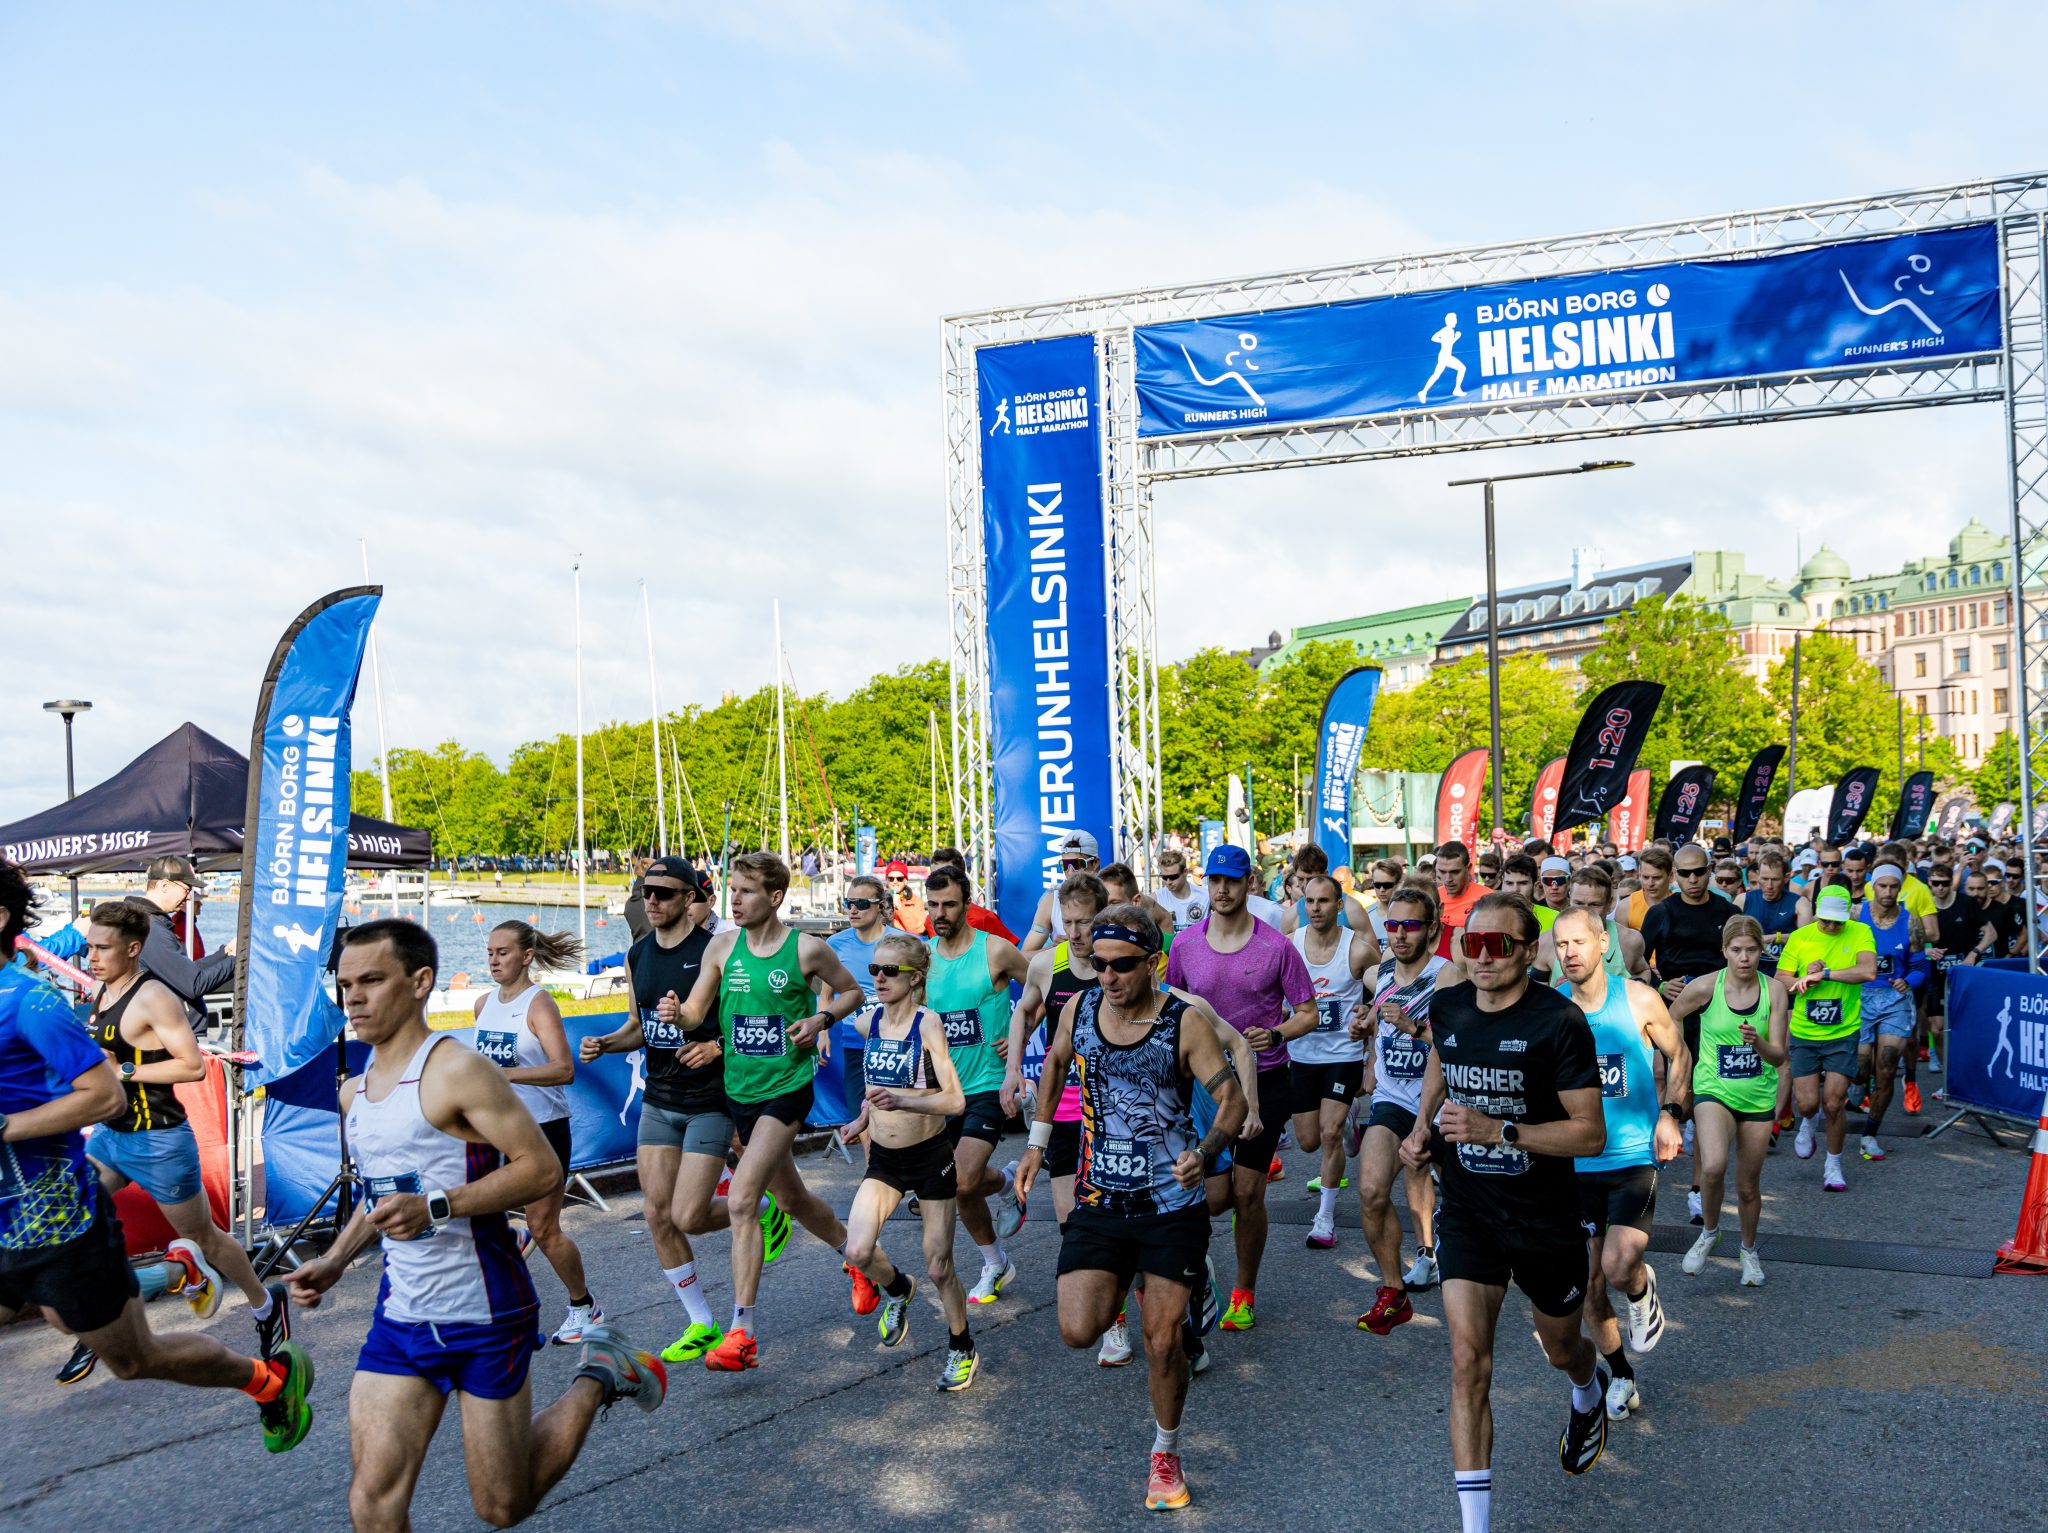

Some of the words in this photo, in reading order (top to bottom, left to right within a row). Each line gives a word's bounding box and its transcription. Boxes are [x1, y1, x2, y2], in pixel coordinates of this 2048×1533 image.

[1477, 297, 1559, 324] BJÖRN
[1566, 288, 1637, 315] BORG
[1478, 311, 1675, 377] HELSINKI
[1844, 338, 1909, 357] RUNNER'S
[1911, 335, 1945, 350] HIGH
[1014, 392, 1047, 404] BJÖRN
[1048, 388, 1075, 399] BORG
[1482, 379, 1539, 401] HALF
[1546, 365, 1676, 396] MARATHON
[1015, 398, 1088, 426] HELSINKI
[1184, 410, 1237, 423] RUNNER'S
[1239, 407, 1268, 419] HIGH
[1016, 426, 1040, 436] HALF
[1041, 419, 1089, 434] MARATHON
[1325, 736, 1335, 769] BORG
[1588, 707, 1632, 770] 1:20
[278, 745, 300, 817] BORG
[1322, 770, 1333, 809] BJÖRN
[1671, 783, 1700, 824] 1:25
[1841, 781, 1865, 817] 1:30
[1620, 811, 1630, 845] BORG
[4, 834, 98, 862] RUNNER'S
[100, 830, 152, 852] HIGH
[359, 834, 402, 855] HIGH
[273, 822, 294, 905] BJÖRN
[1810, 1006, 1838, 1021] 497
[736, 1026, 780, 1046] 3596
[943, 1019, 975, 1039] 2961
[867, 1051, 908, 1074] 3567
[1385, 1049, 1424, 1070] 2270
[1723, 1053, 1759, 1069] 3415
[1440, 1062, 1525, 1092] FINISHER
[1108, 1143, 1133, 1152] HELSINKI
[1095, 1151, 1147, 1178] 3382
